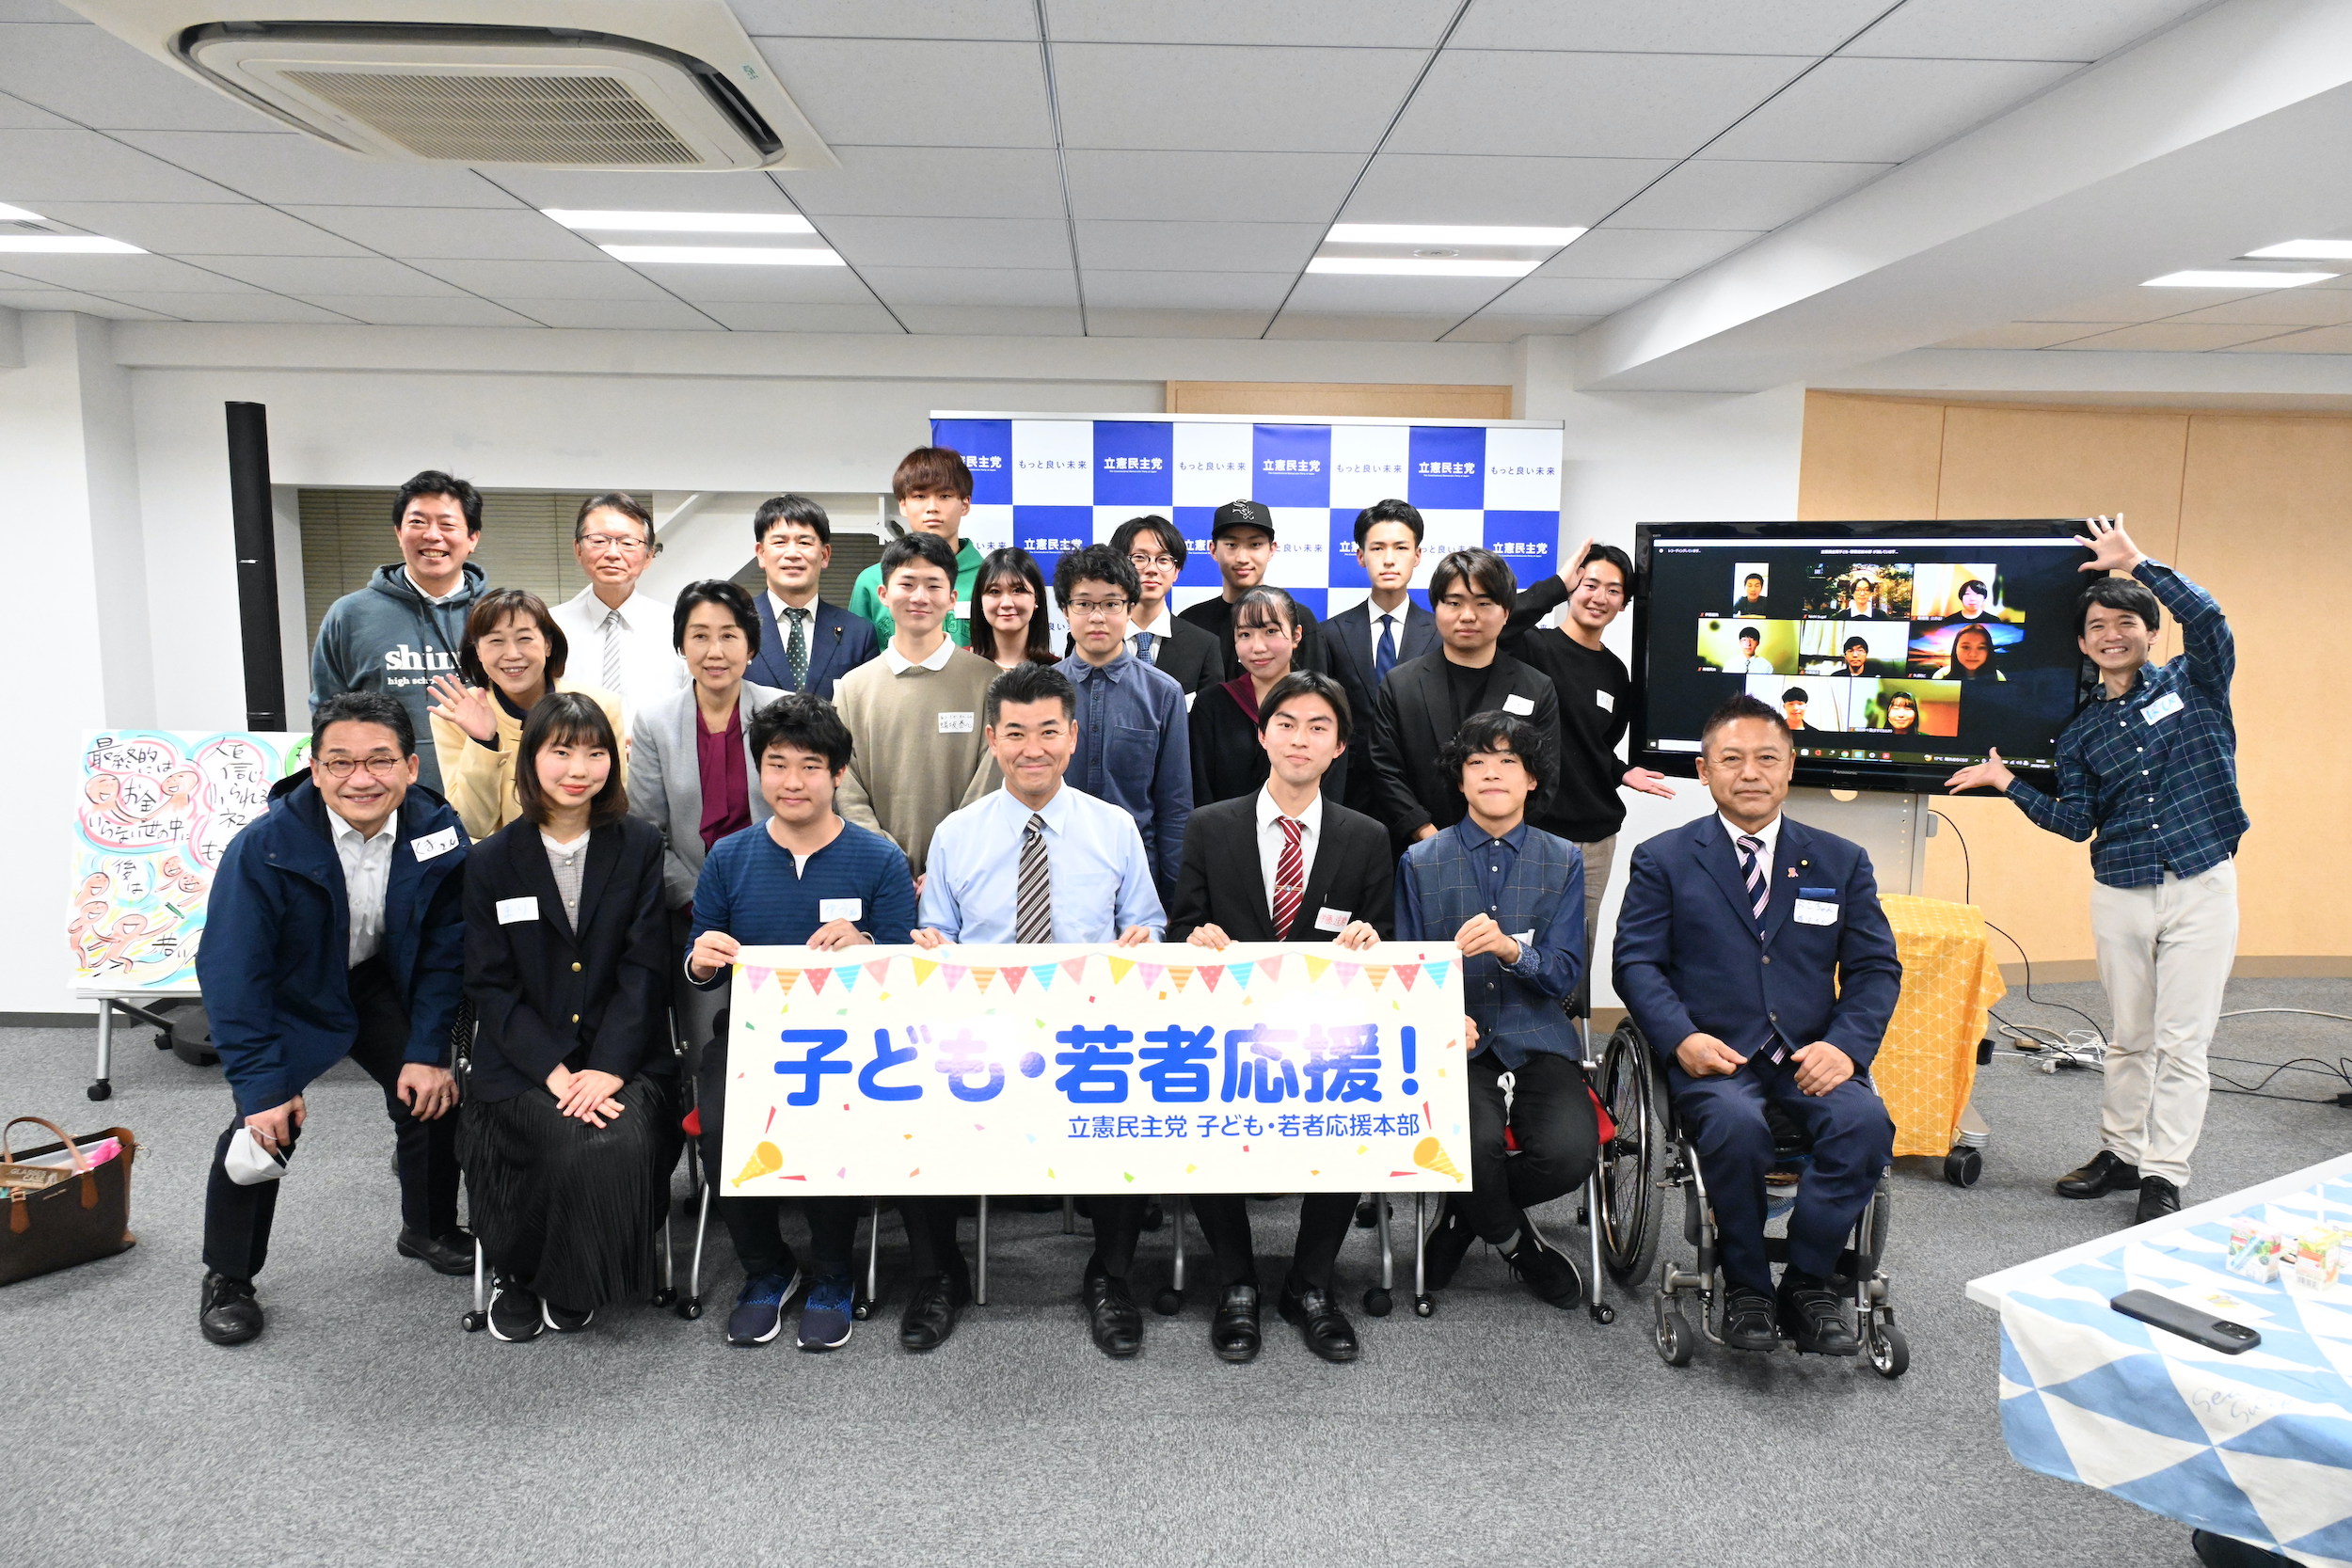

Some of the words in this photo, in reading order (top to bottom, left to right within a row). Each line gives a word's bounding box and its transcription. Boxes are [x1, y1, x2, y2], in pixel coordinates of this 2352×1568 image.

[1019, 460, 1087, 469] もっと良い未来
[1104, 457, 1163, 470] 立憲民主党
[1179, 462, 1247, 471] もっと良い未来
[1263, 459, 1321, 472] 立憲民主党
[1337, 464, 1402, 473] もっと良い未来
[1419, 461, 1475, 474] 立憲民主党
[1491, 467, 1555, 476] もっと良い未来
[1024, 538, 1083, 551] 立憲民主党
[1493, 542, 1548, 555] 立憲民主党
[388, 677, 410, 687] high
[121, 778, 156, 812] お金
[1068, 1116, 1187, 1138] 立憲民主党
[1197, 1113, 1420, 1138] 子ども・若者応援本部
